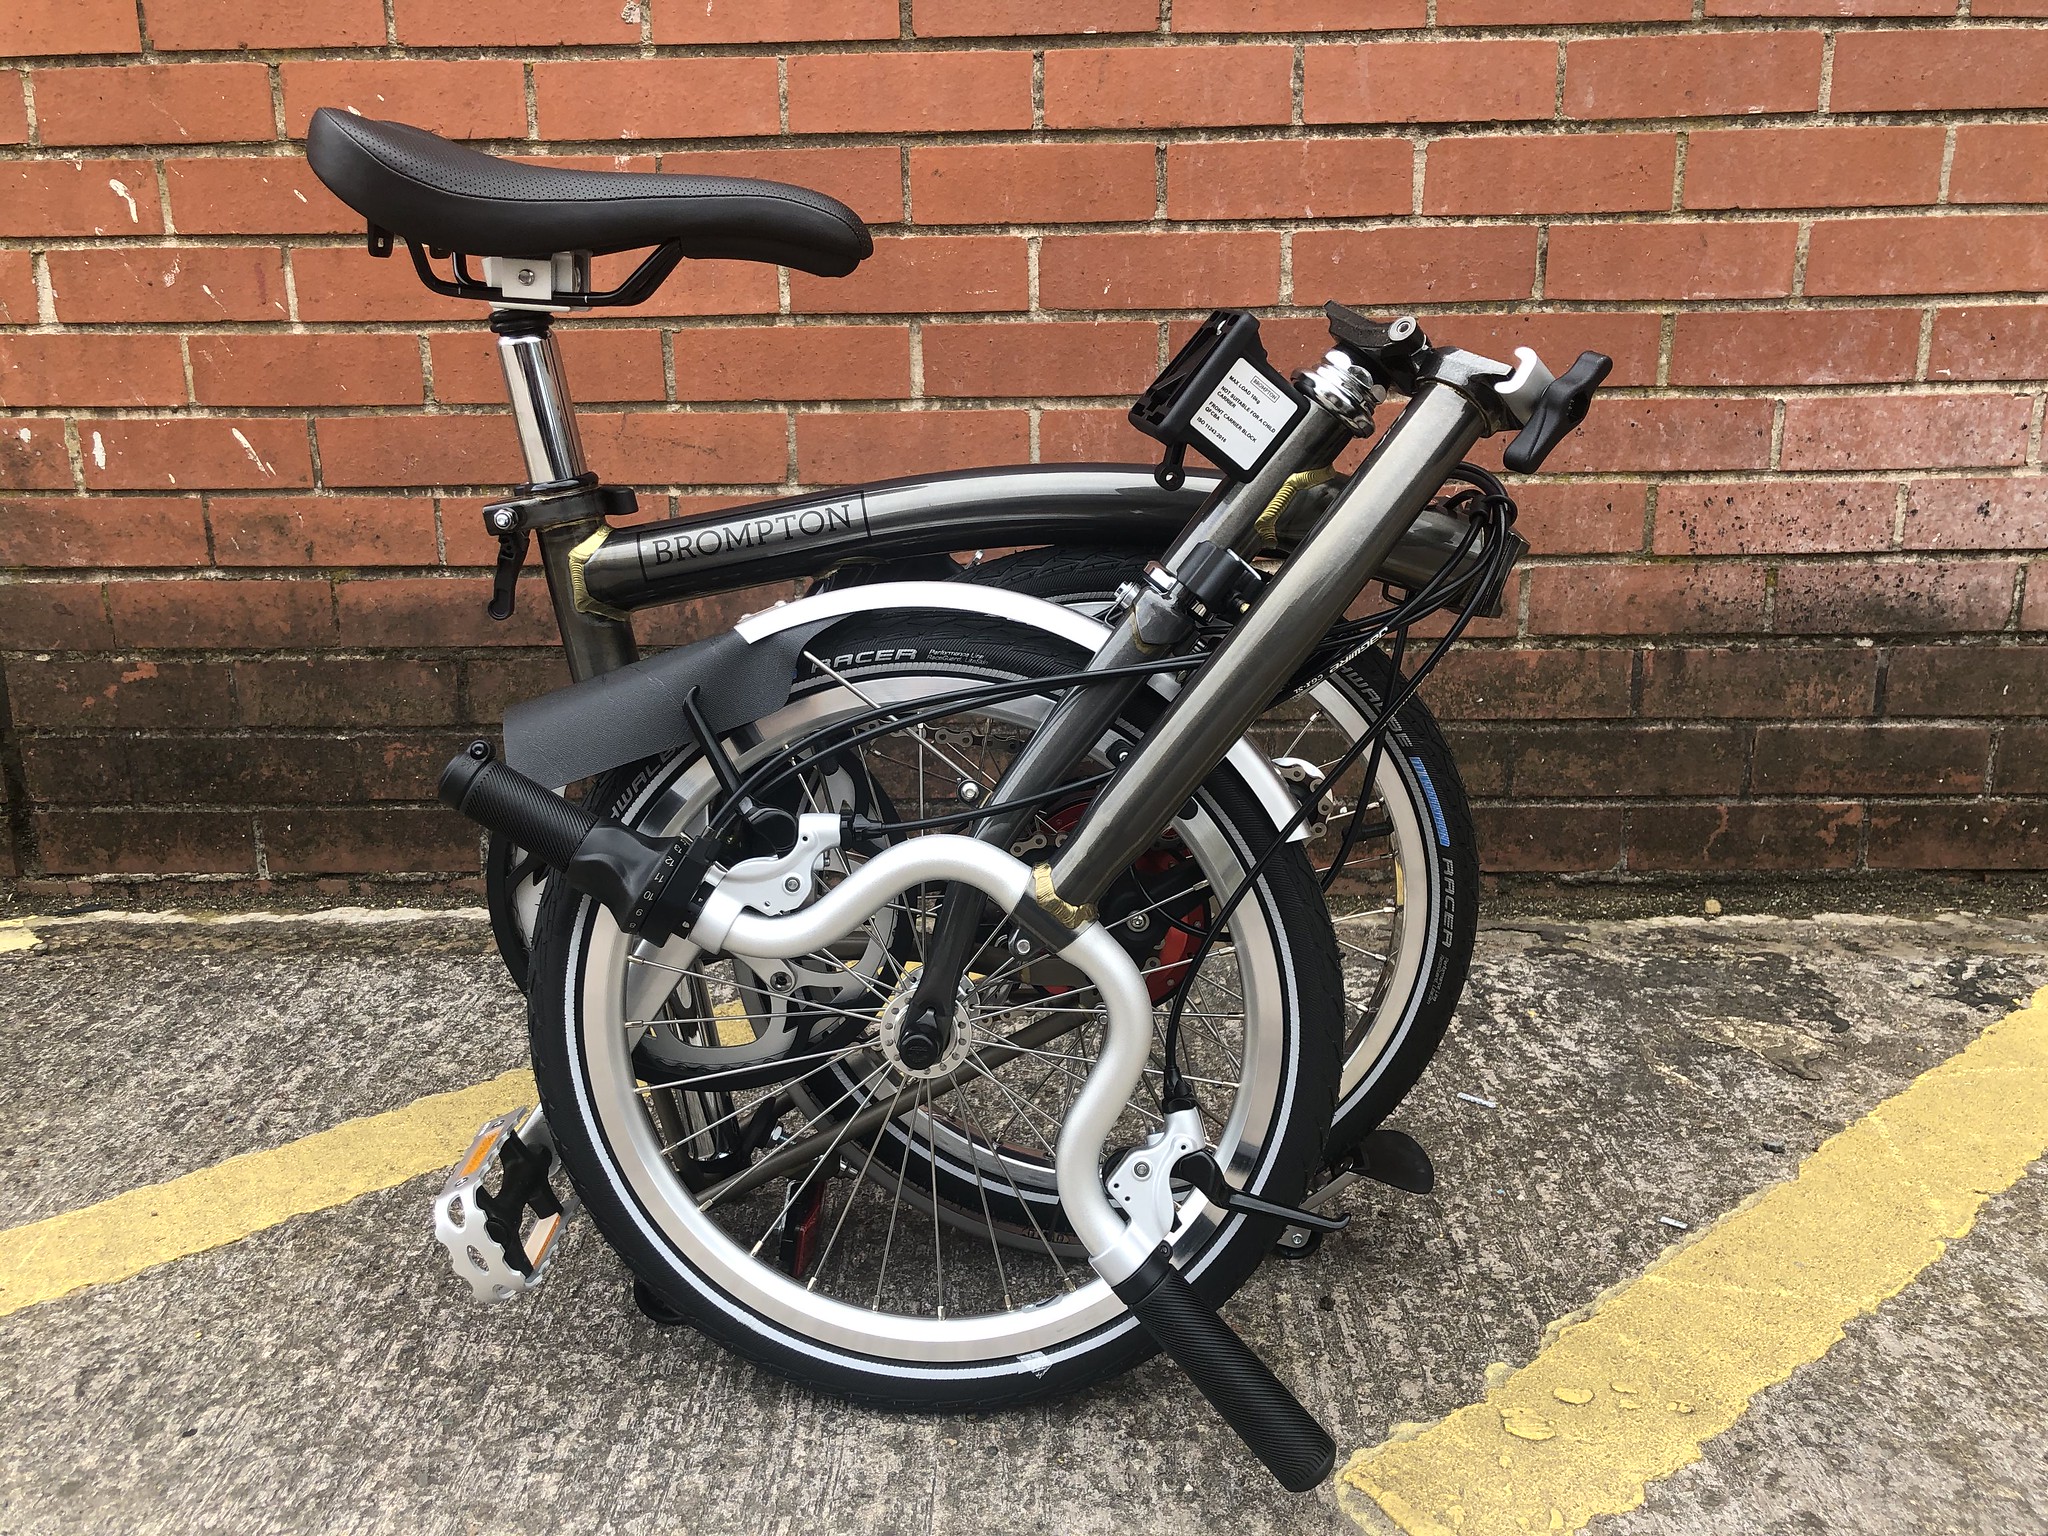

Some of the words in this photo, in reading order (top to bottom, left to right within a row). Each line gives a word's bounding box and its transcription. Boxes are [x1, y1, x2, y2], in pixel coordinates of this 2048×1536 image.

[1229, 375, 1239, 386] MAX
[1239, 383, 1252, 395] LOAD
[1253, 379, 1277, 400] BROMPTON
[1217, 391, 1237, 409] CARRIER
[1220, 385, 1231, 396] NOT
[1231, 393, 1250, 412] SUITABLE
[1250, 410, 1260, 420] FOR
[1262, 420, 1276, 434] CHILD
[1196, 416, 1206, 426] ISO
[1208, 401, 1224, 415] FRONT
[1223, 413, 1243, 431] CARRIER
[1241, 428, 1257, 443] BLOCK
[652, 503, 852, 565] BROMPTON
[810, 648, 918, 674] RACER
[673, 844, 683, 854] 13
[664, 855, 675, 867] 12
[654, 872, 665, 883] 11
[643, 890, 654, 901] 10
[1441, 857, 1454, 948] RACER
[635, 908, 643, 916] 9
